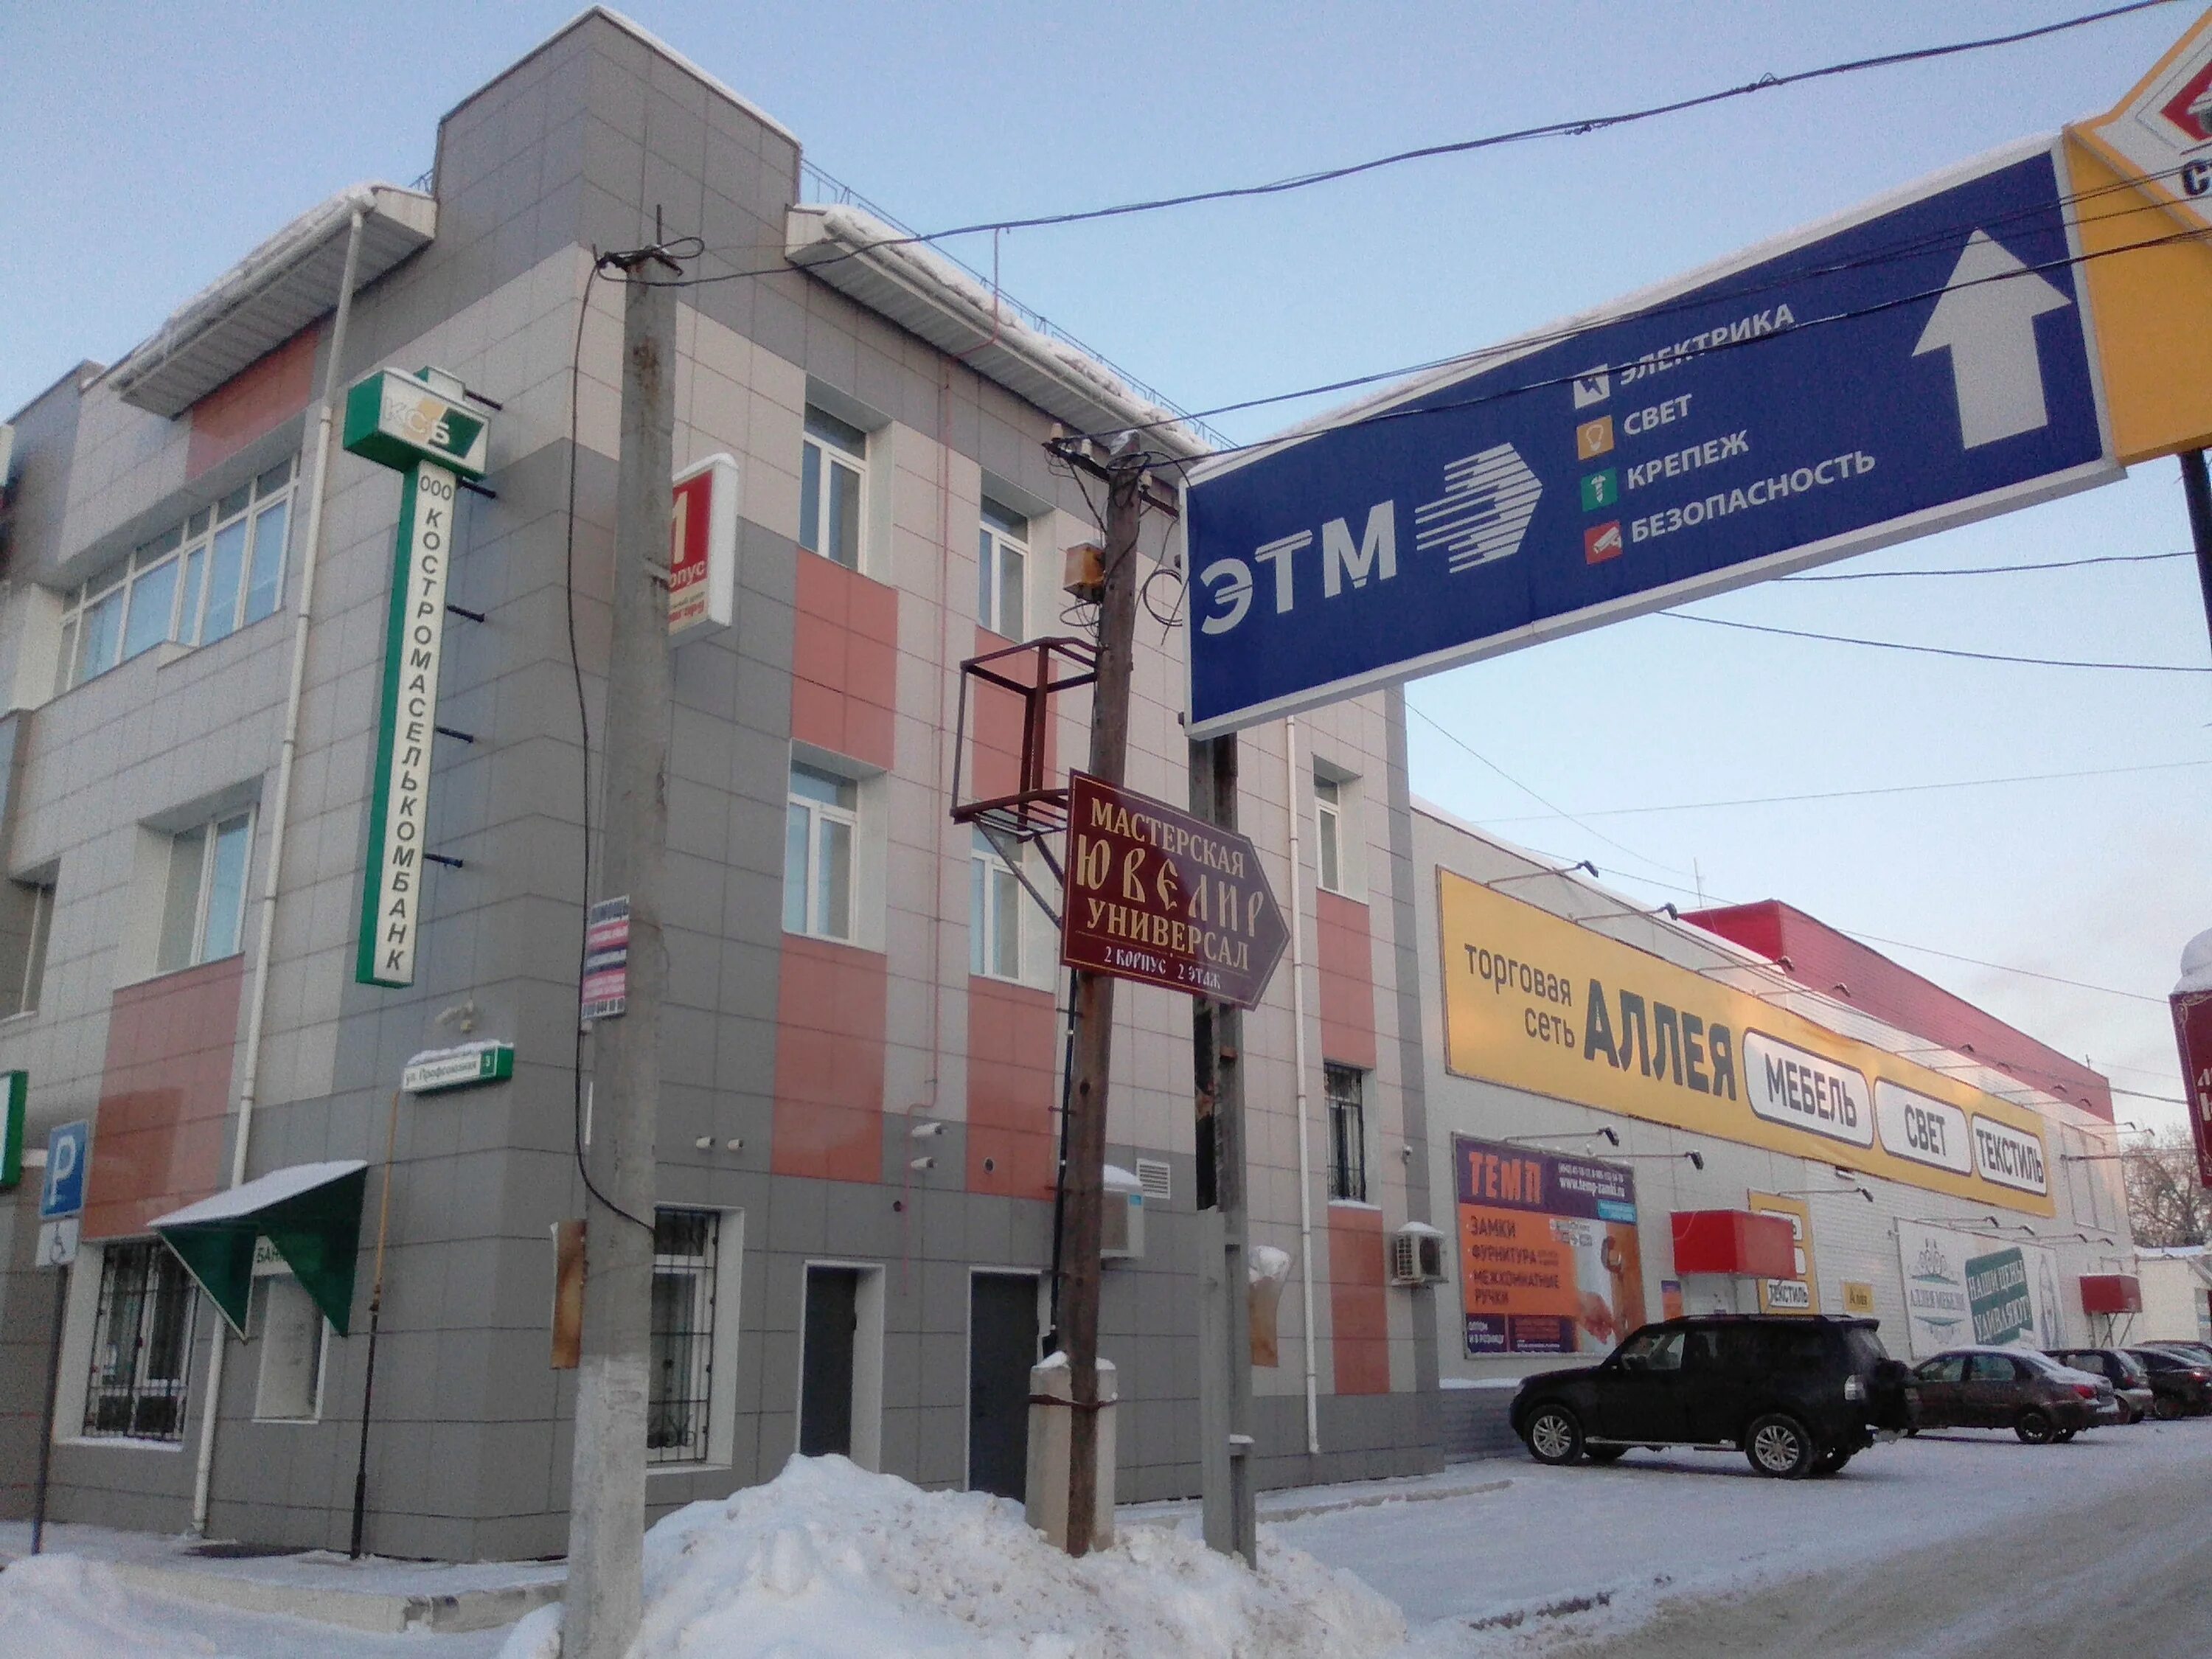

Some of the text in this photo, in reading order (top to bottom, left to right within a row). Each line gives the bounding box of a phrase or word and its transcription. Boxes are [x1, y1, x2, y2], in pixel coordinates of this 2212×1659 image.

[1620, 304, 1795, 386] ЭЛЕКТРИКА
[1624, 393, 1693, 436] СВЕТ
[420, 475, 452, 501] ООО
[1627, 429, 1749, 490] КРЕПЕЖ
[1631, 451, 1876, 543] БЕЗОПАСНОСТЬ
[1200, 499, 1397, 636] ЭТМ
[386, 507, 443, 971] КОСТРОМАСЕЛЬКОМБАНК
[1091, 797, 1244, 878] МАСТЕРСКАЯ
[1077, 834, 1264, 937] ЮВЕЛИР
[1087, 897, 1249, 970] УНИВЕРСАЛ
[1104, 946, 1221, 990] 2 КОРПУС 2 ЭТАЖ
[1464, 943, 1573, 1007] торговая
[1525, 978, 2045, 1184] сеть АЛЛЕЯ МЕБЕЛЬ СВЕТ ТЕКСТИЛЬ
[1469, 1151, 1542, 1204] ТЕМП
[1470, 1215, 1516, 1239] ЗАМКИ
[1472, 1244, 1536, 1265] ФУРНИТУРА
